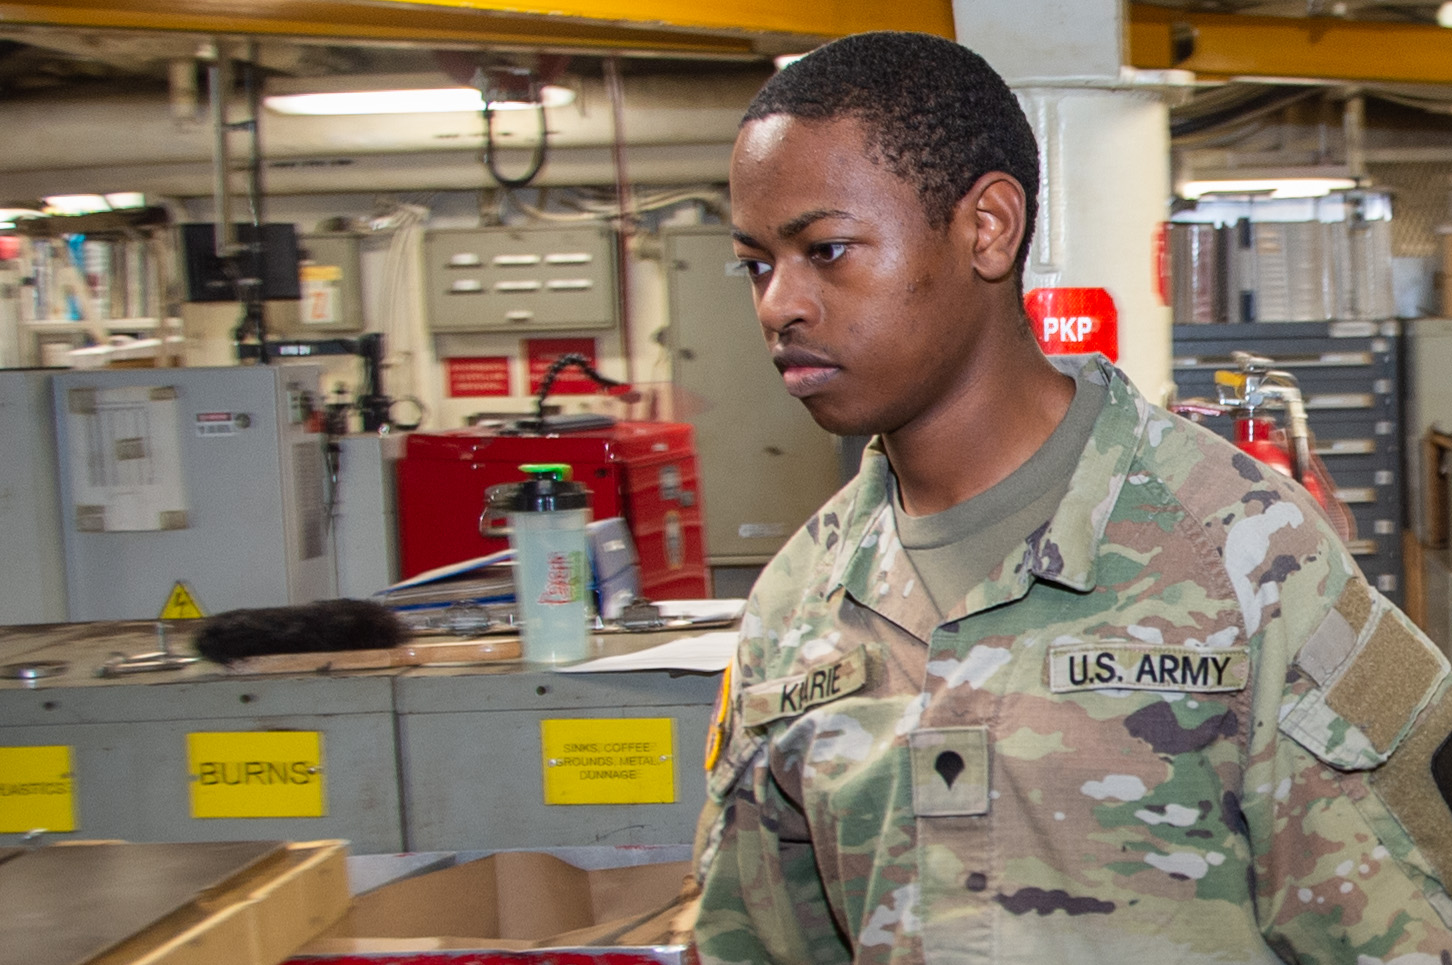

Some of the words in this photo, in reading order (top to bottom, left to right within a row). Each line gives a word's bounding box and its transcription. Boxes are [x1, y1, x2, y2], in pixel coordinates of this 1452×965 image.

[1043, 316, 1092, 342] PKP
[1069, 652, 1123, 686] U.S.
[1136, 653, 1232, 686] ARMY
[603, 742, 652, 753] COFFEE
[200, 760, 310, 786] BURNS
[579, 769, 639, 781] DUNNAGE
